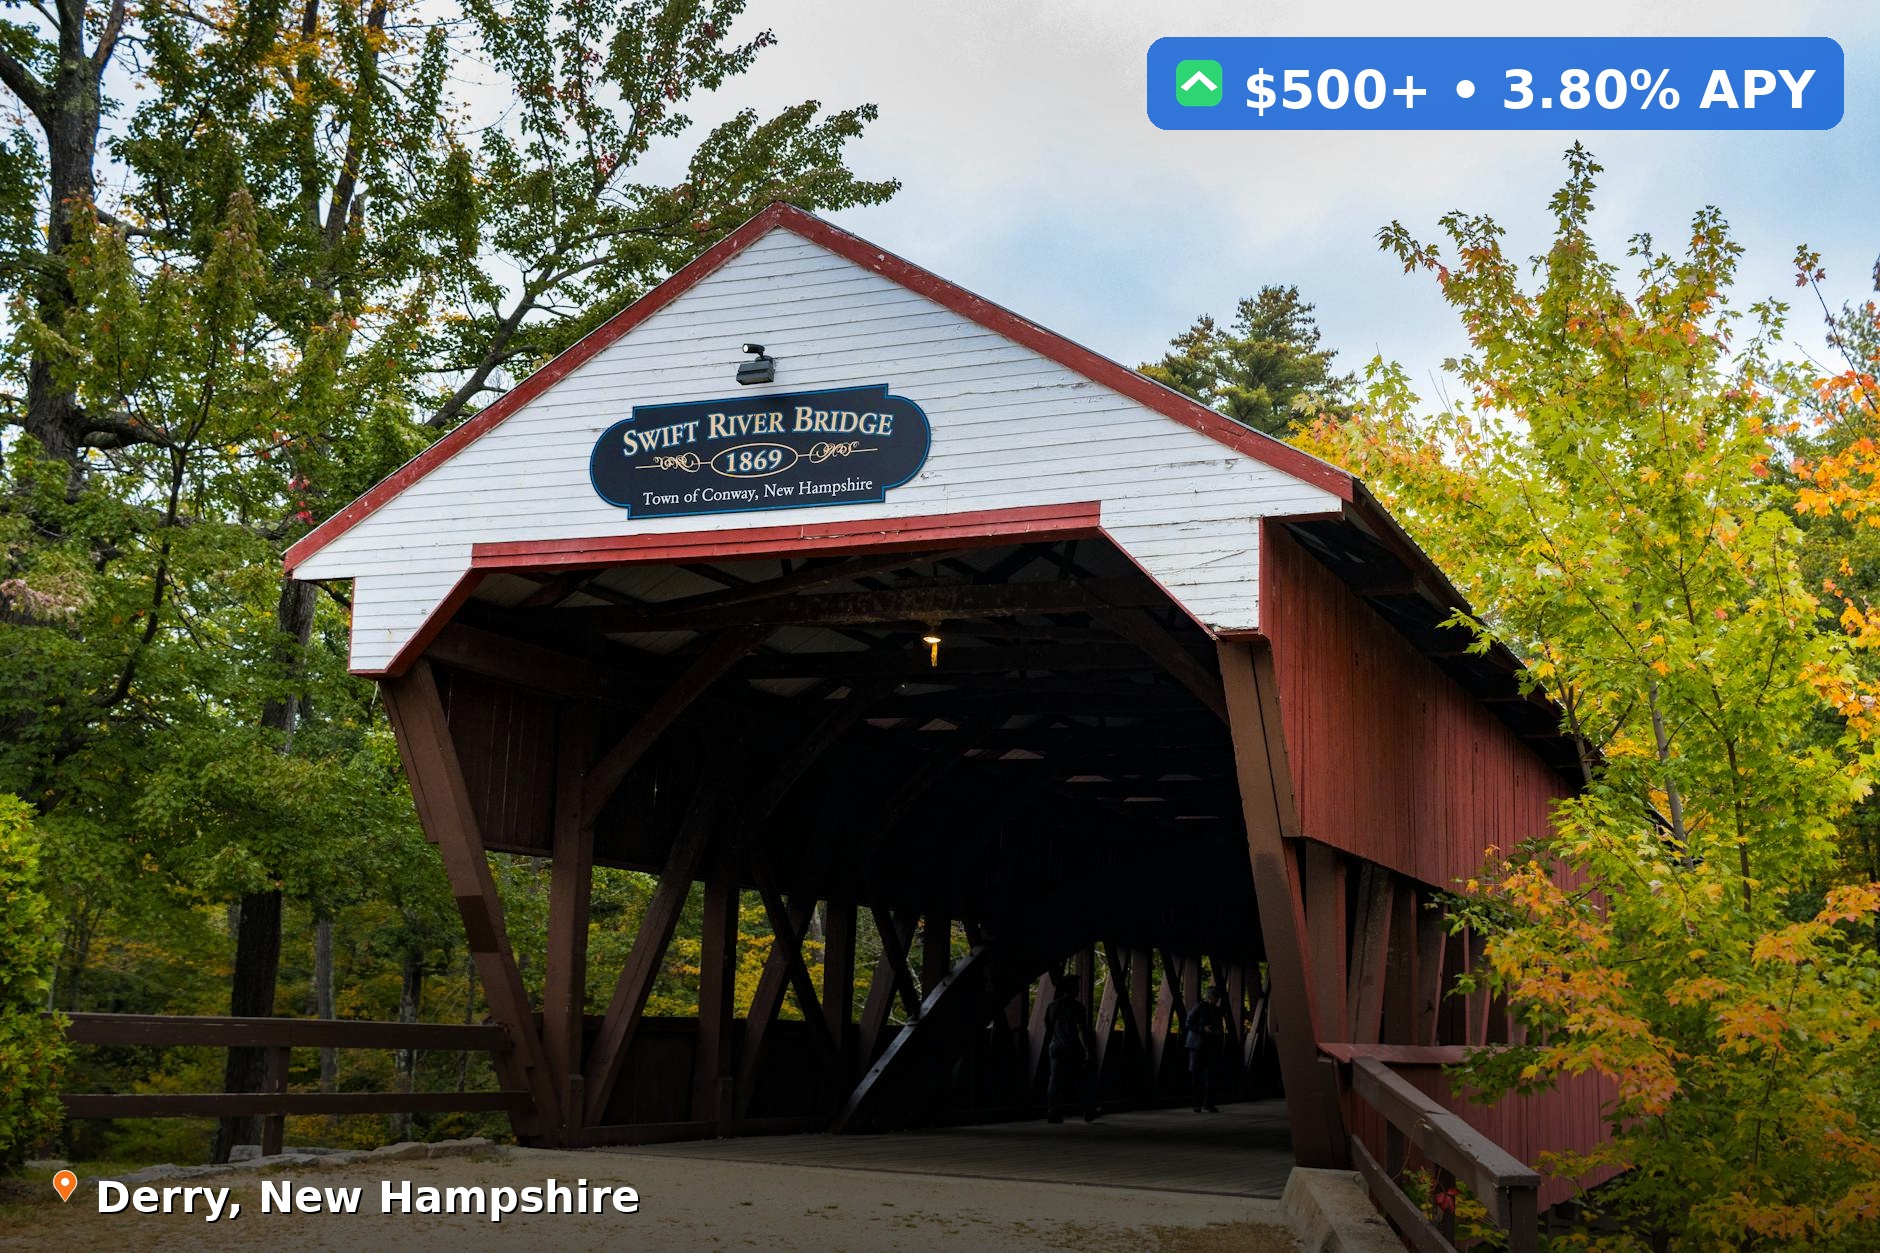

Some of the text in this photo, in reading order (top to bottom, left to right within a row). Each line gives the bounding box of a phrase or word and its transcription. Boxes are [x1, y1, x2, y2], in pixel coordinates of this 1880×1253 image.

[623, 406, 894, 457] SWIFT RIVER BRIDGE
[725, 448, 783, 474] 1869
[643, 477, 874, 506] Town of Conway, New Hampshire
